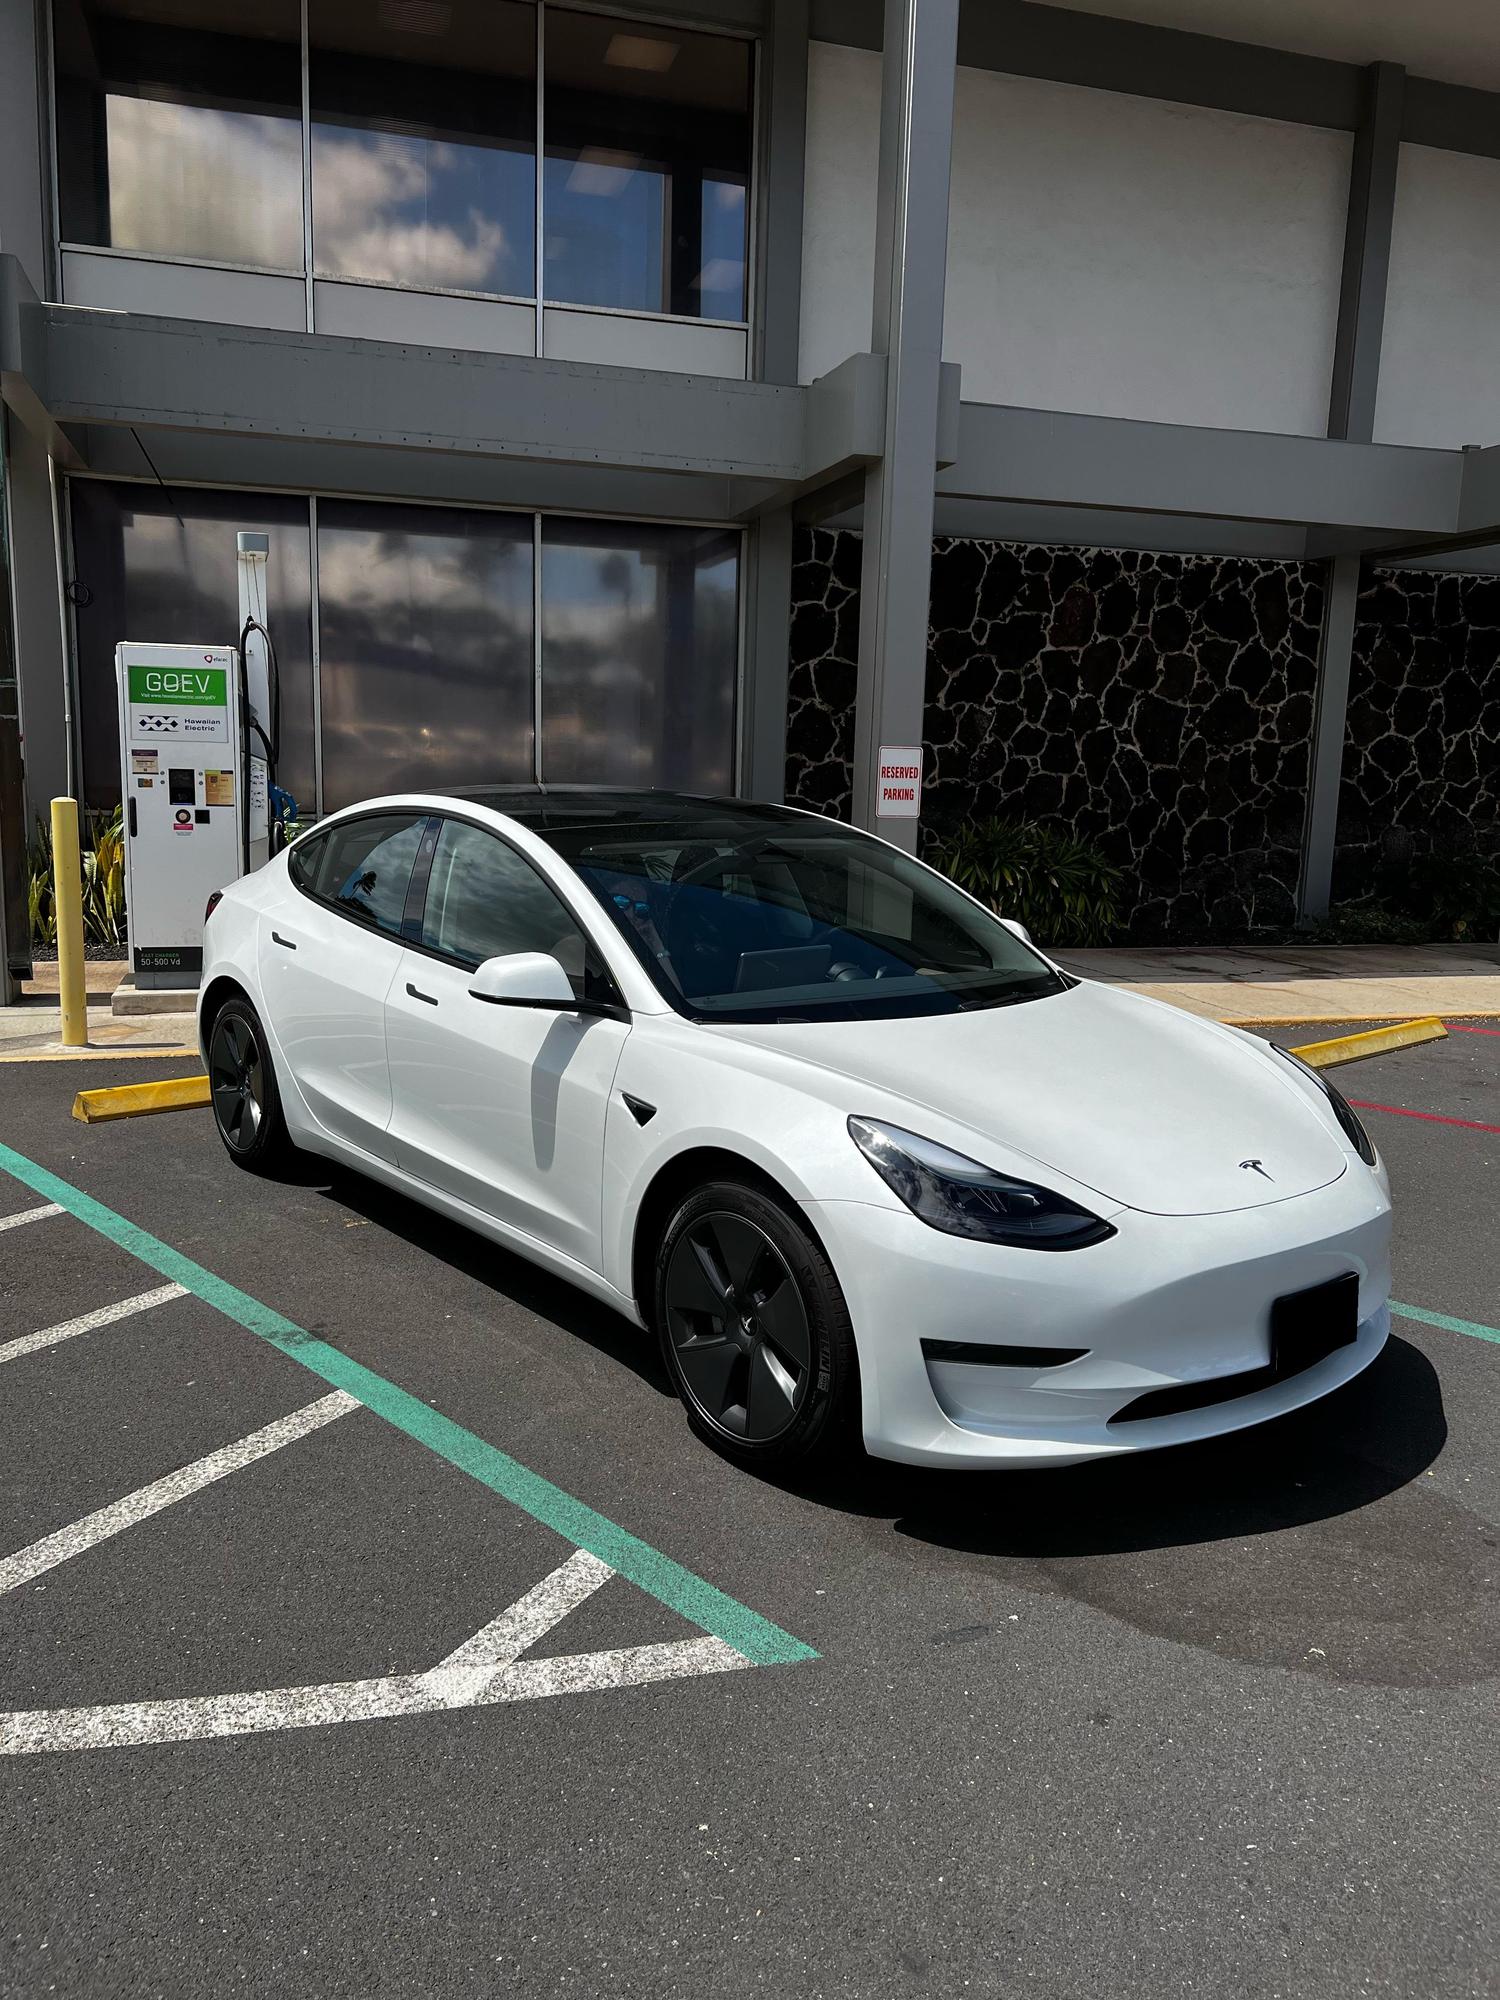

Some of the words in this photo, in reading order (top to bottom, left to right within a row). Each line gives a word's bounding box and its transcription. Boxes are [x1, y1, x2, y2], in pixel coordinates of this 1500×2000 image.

[146, 673, 210, 693] GOEV
[881, 767, 918, 778] RESERVED
[883, 788, 914, 800] PARKING
[141, 958, 169, 966] 50-500
